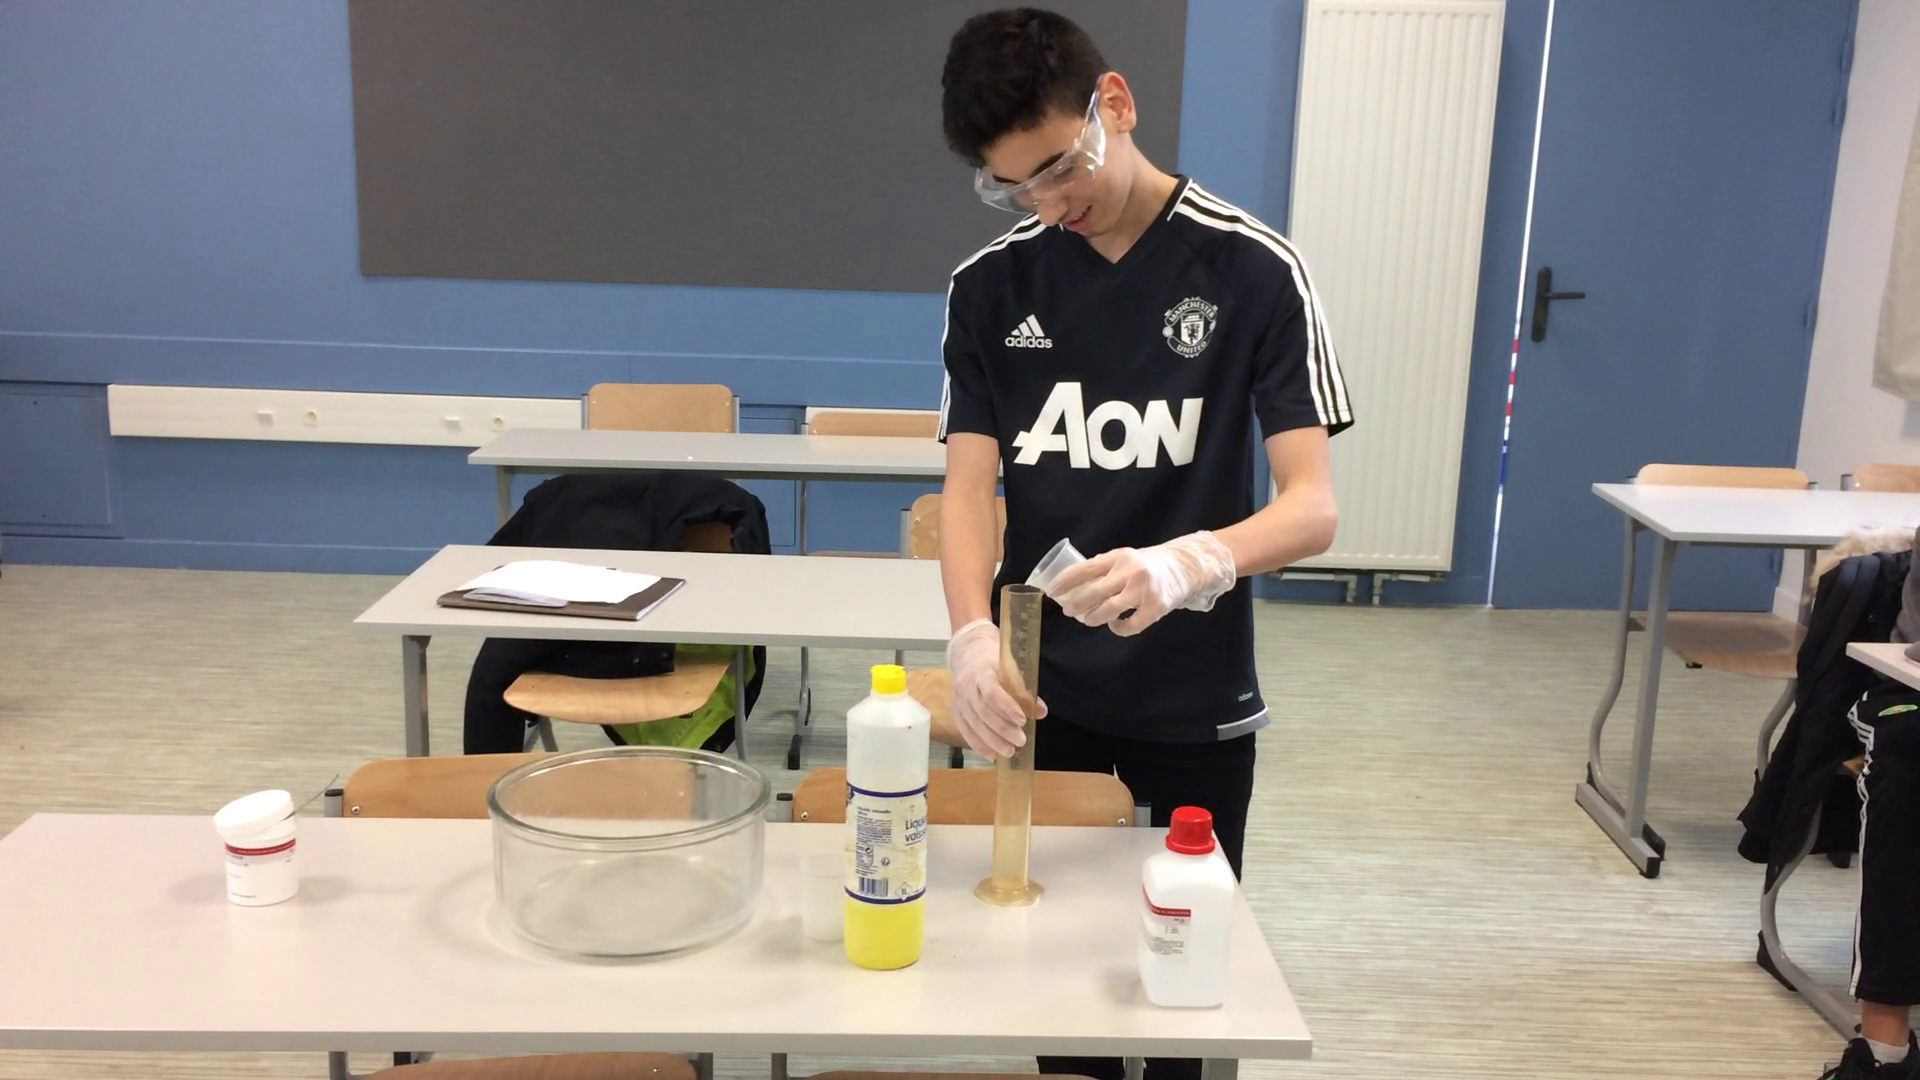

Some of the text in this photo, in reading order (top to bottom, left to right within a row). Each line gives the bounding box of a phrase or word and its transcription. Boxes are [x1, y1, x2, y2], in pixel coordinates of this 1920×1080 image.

[1168, 301, 1216, 323] MANCHESTER
[1004, 335, 1053, 349] adidas
[1176, 339, 1208, 355] UNITED
